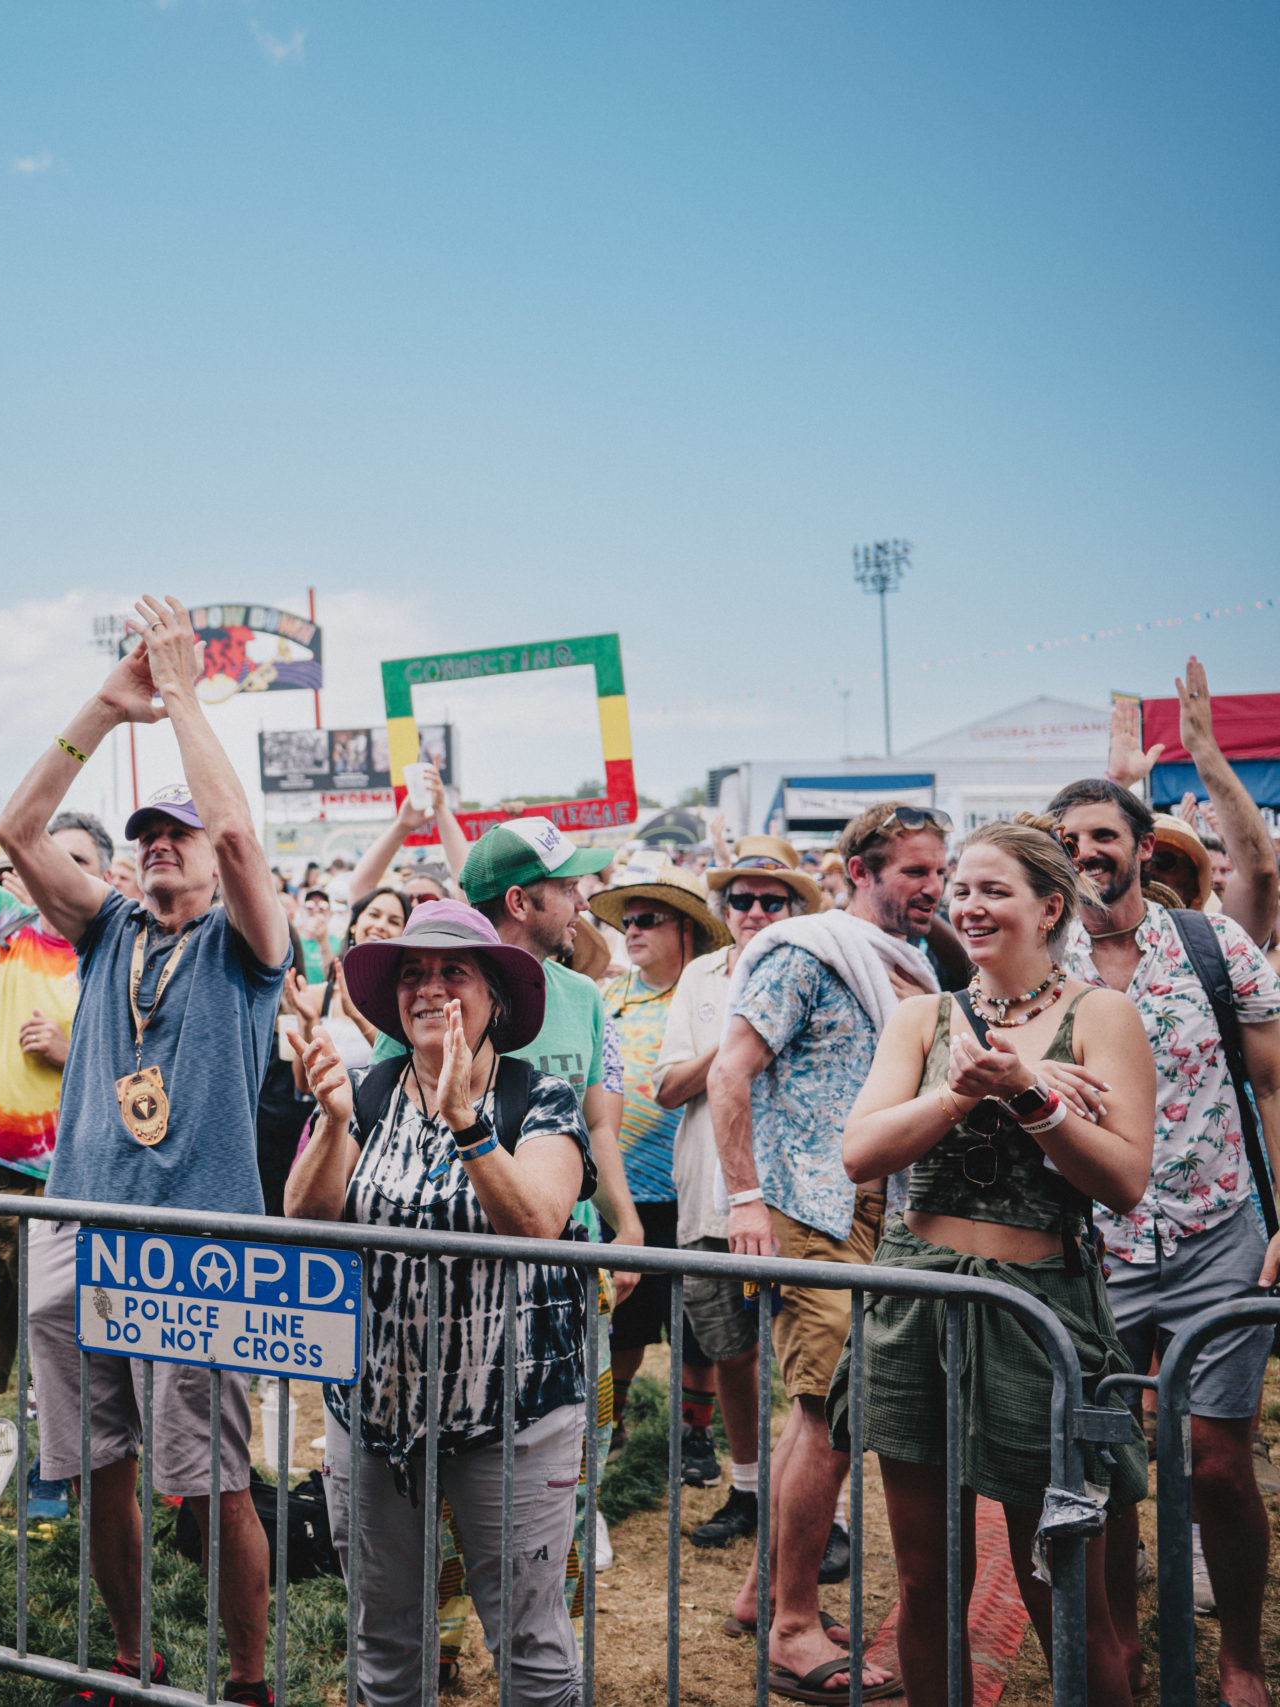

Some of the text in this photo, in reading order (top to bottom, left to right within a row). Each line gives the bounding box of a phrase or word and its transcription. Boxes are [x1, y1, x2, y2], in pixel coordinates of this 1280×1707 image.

[405, 644, 575, 684] CONNECTING
[1040, 719, 1113, 736] EXCHANG
[551, 802, 631, 826] REGGAE
[124, 1296, 305, 1339] POLICE LINE
[107, 1320, 323, 1368] DO NOT CROSS
